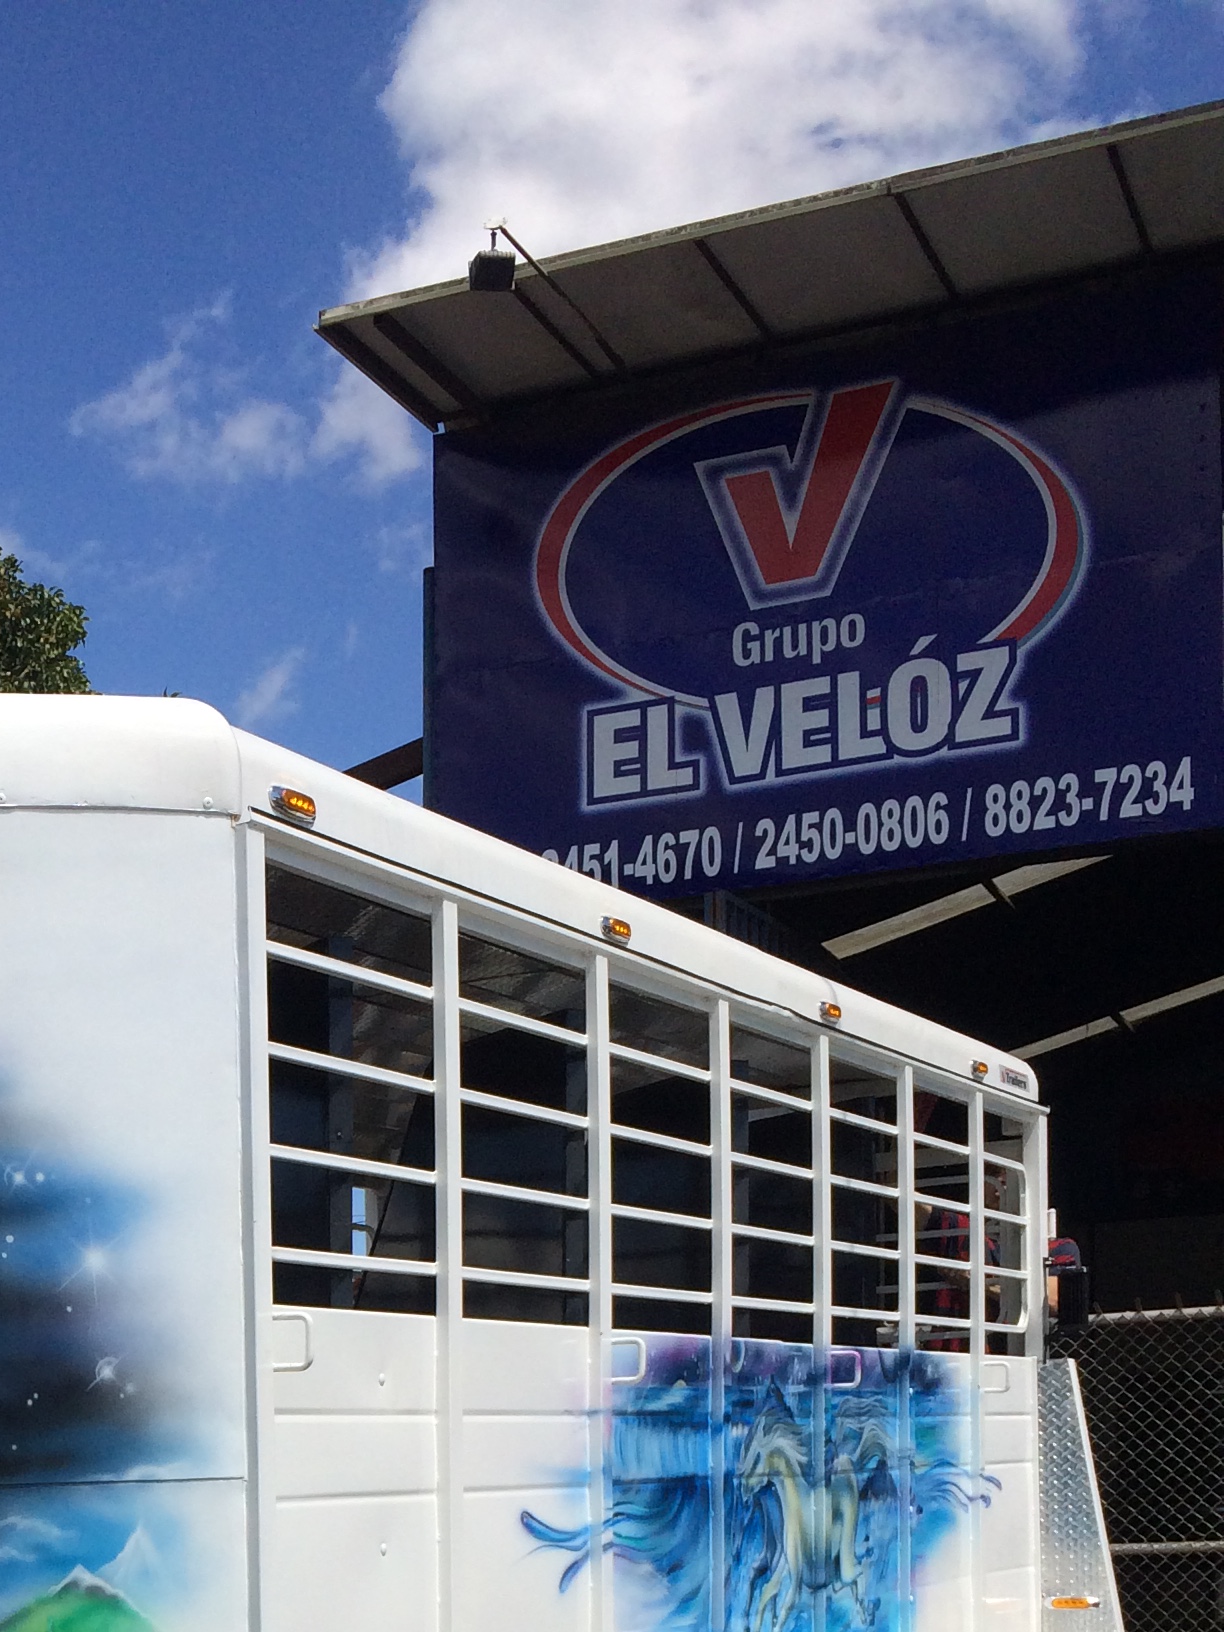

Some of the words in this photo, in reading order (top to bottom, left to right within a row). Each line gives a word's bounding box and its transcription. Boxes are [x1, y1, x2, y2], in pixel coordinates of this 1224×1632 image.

[732, 612, 865, 667] Grupo
[590, 701, 696, 801] EL
[713, 634, 1014, 780] VELÓZ
[754, 791, 950, 870] 2450-0806
[984, 756, 1195, 838] 8823-7234
